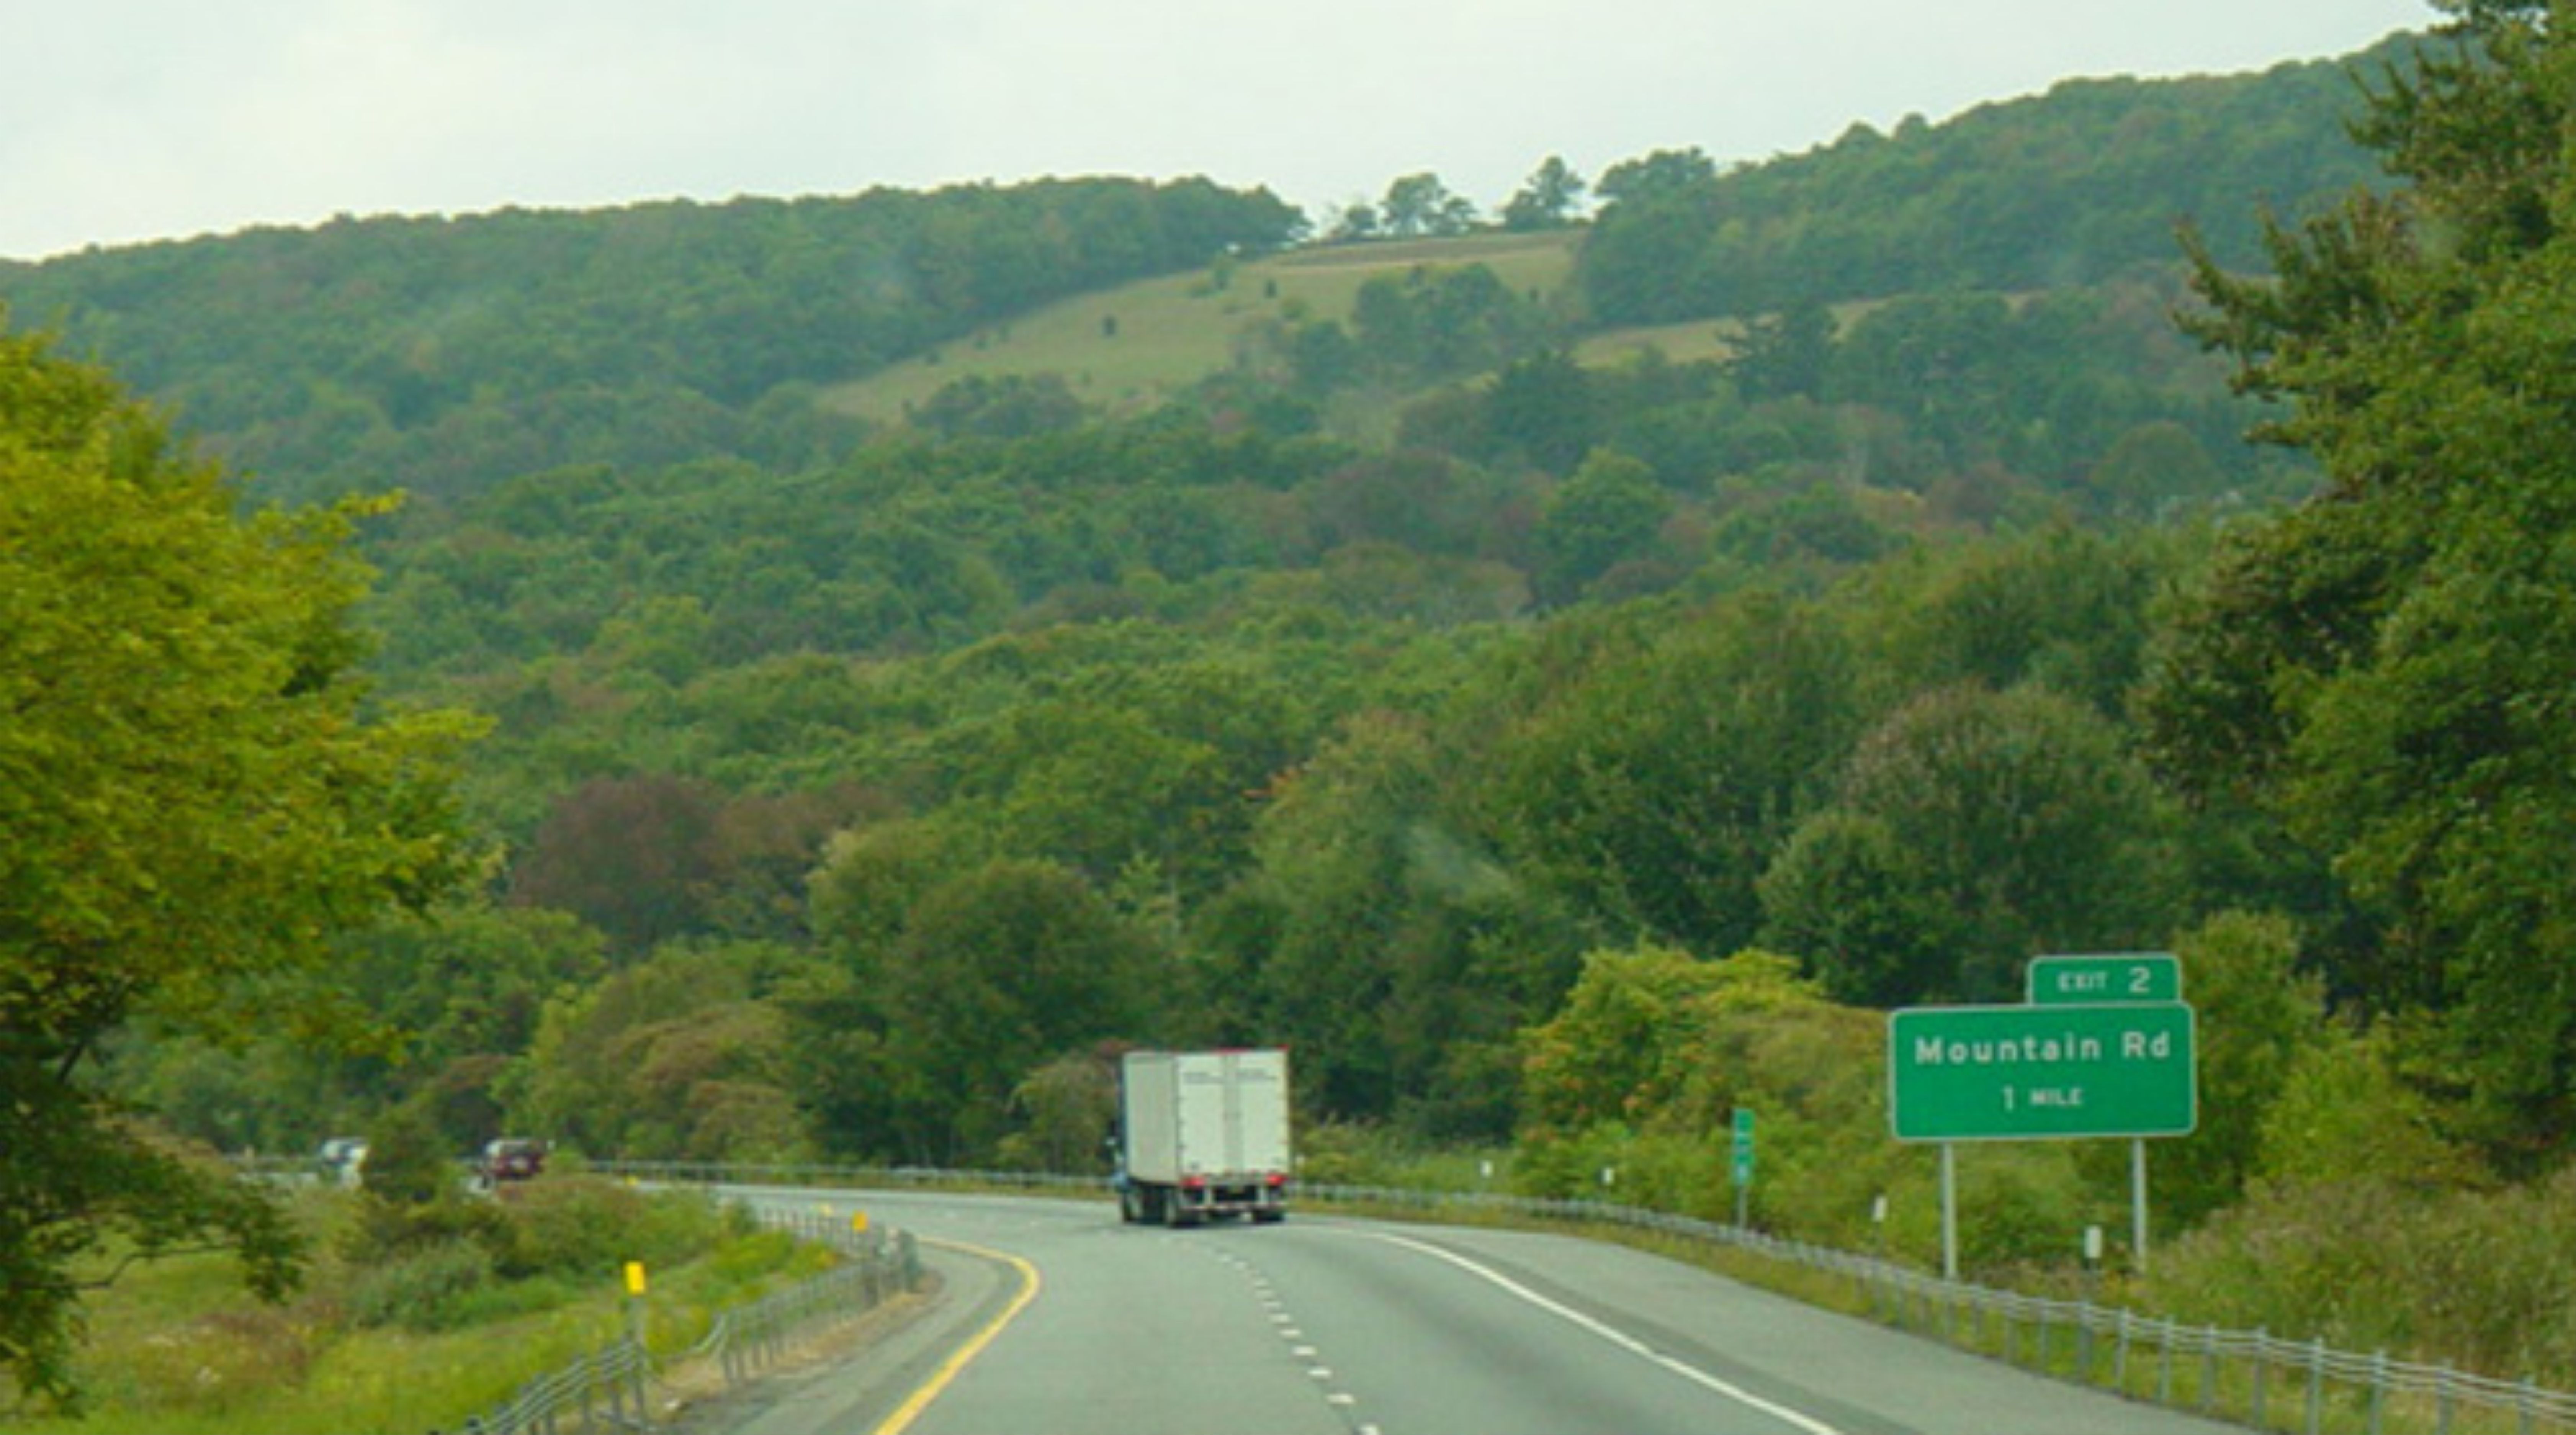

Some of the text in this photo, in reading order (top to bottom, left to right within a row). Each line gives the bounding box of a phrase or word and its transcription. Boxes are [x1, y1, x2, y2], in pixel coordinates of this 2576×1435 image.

[2057, 965, 2151, 994] EXIT 2
[1915, 1030, 2170, 1064] Mountain Rd
[2002, 1085, 2082, 1111] 1 MILE
